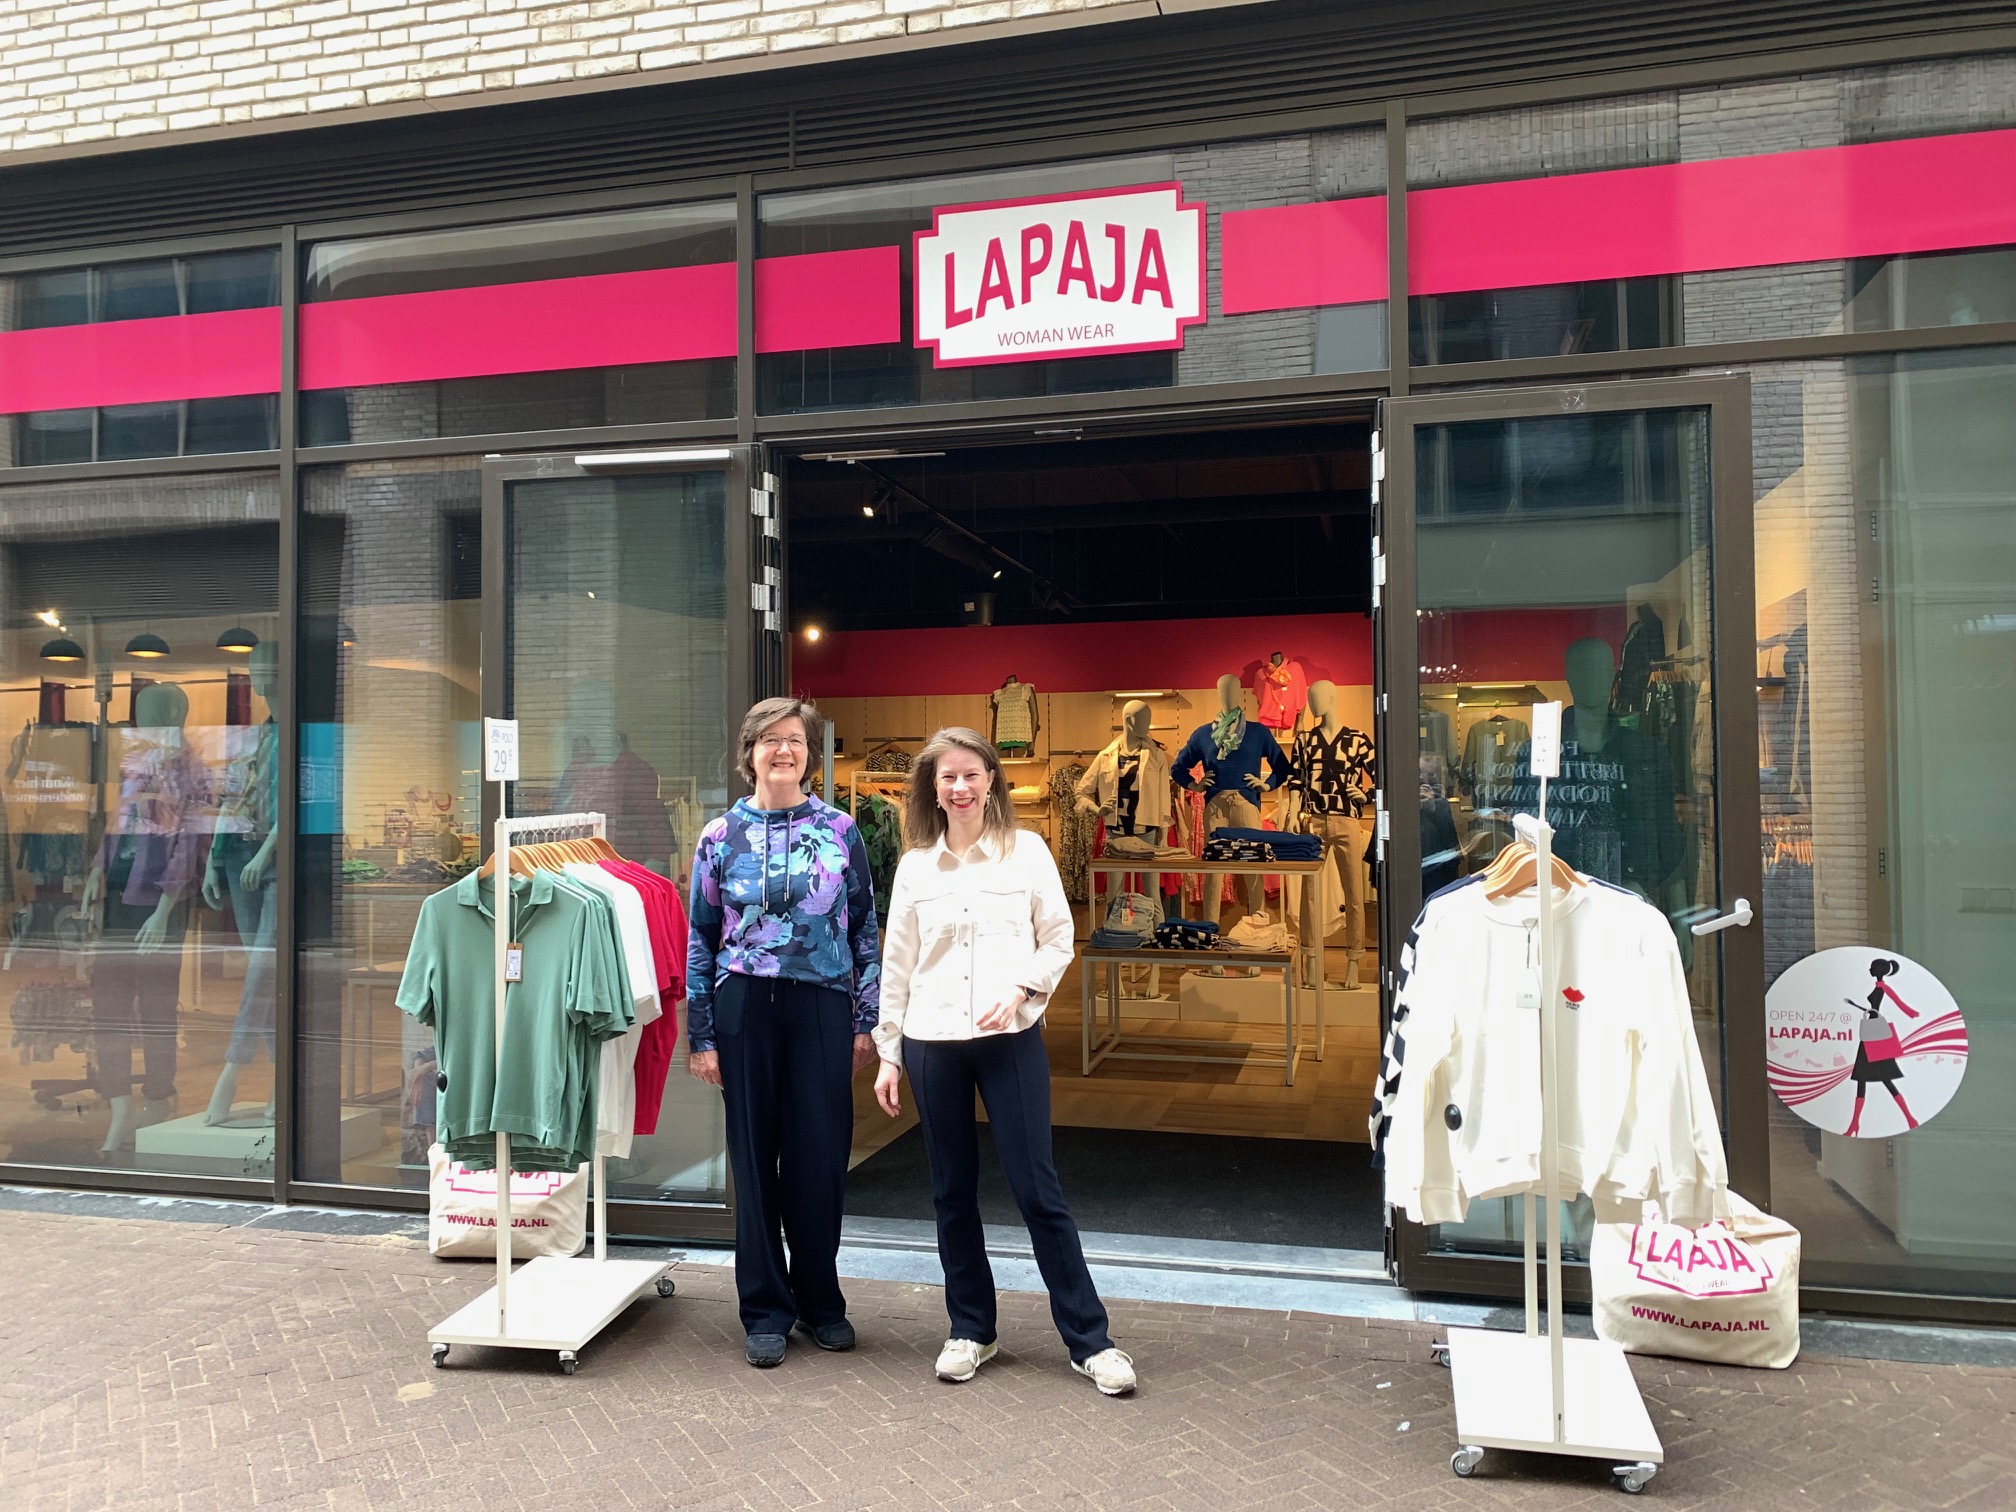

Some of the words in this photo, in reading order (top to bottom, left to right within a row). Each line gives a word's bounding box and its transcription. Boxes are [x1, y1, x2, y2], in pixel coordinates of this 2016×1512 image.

[945, 220, 1174, 329] LAPAJA
[997, 328, 1064, 346] WOMAN
[1067, 323, 1114, 340] WEAR
[1769, 1010, 1805, 1022] OPEN
[1808, 1011, 1836, 1023] 24/7
[1840, 1013, 1852, 1024] @
[1769, 1026, 1853, 1043] LAPAJA.nl
[447, 1215, 549, 1228] WWW.LAJA.NL
[1631, 1306, 1770, 1332] WWW.LAPAJA.NL
